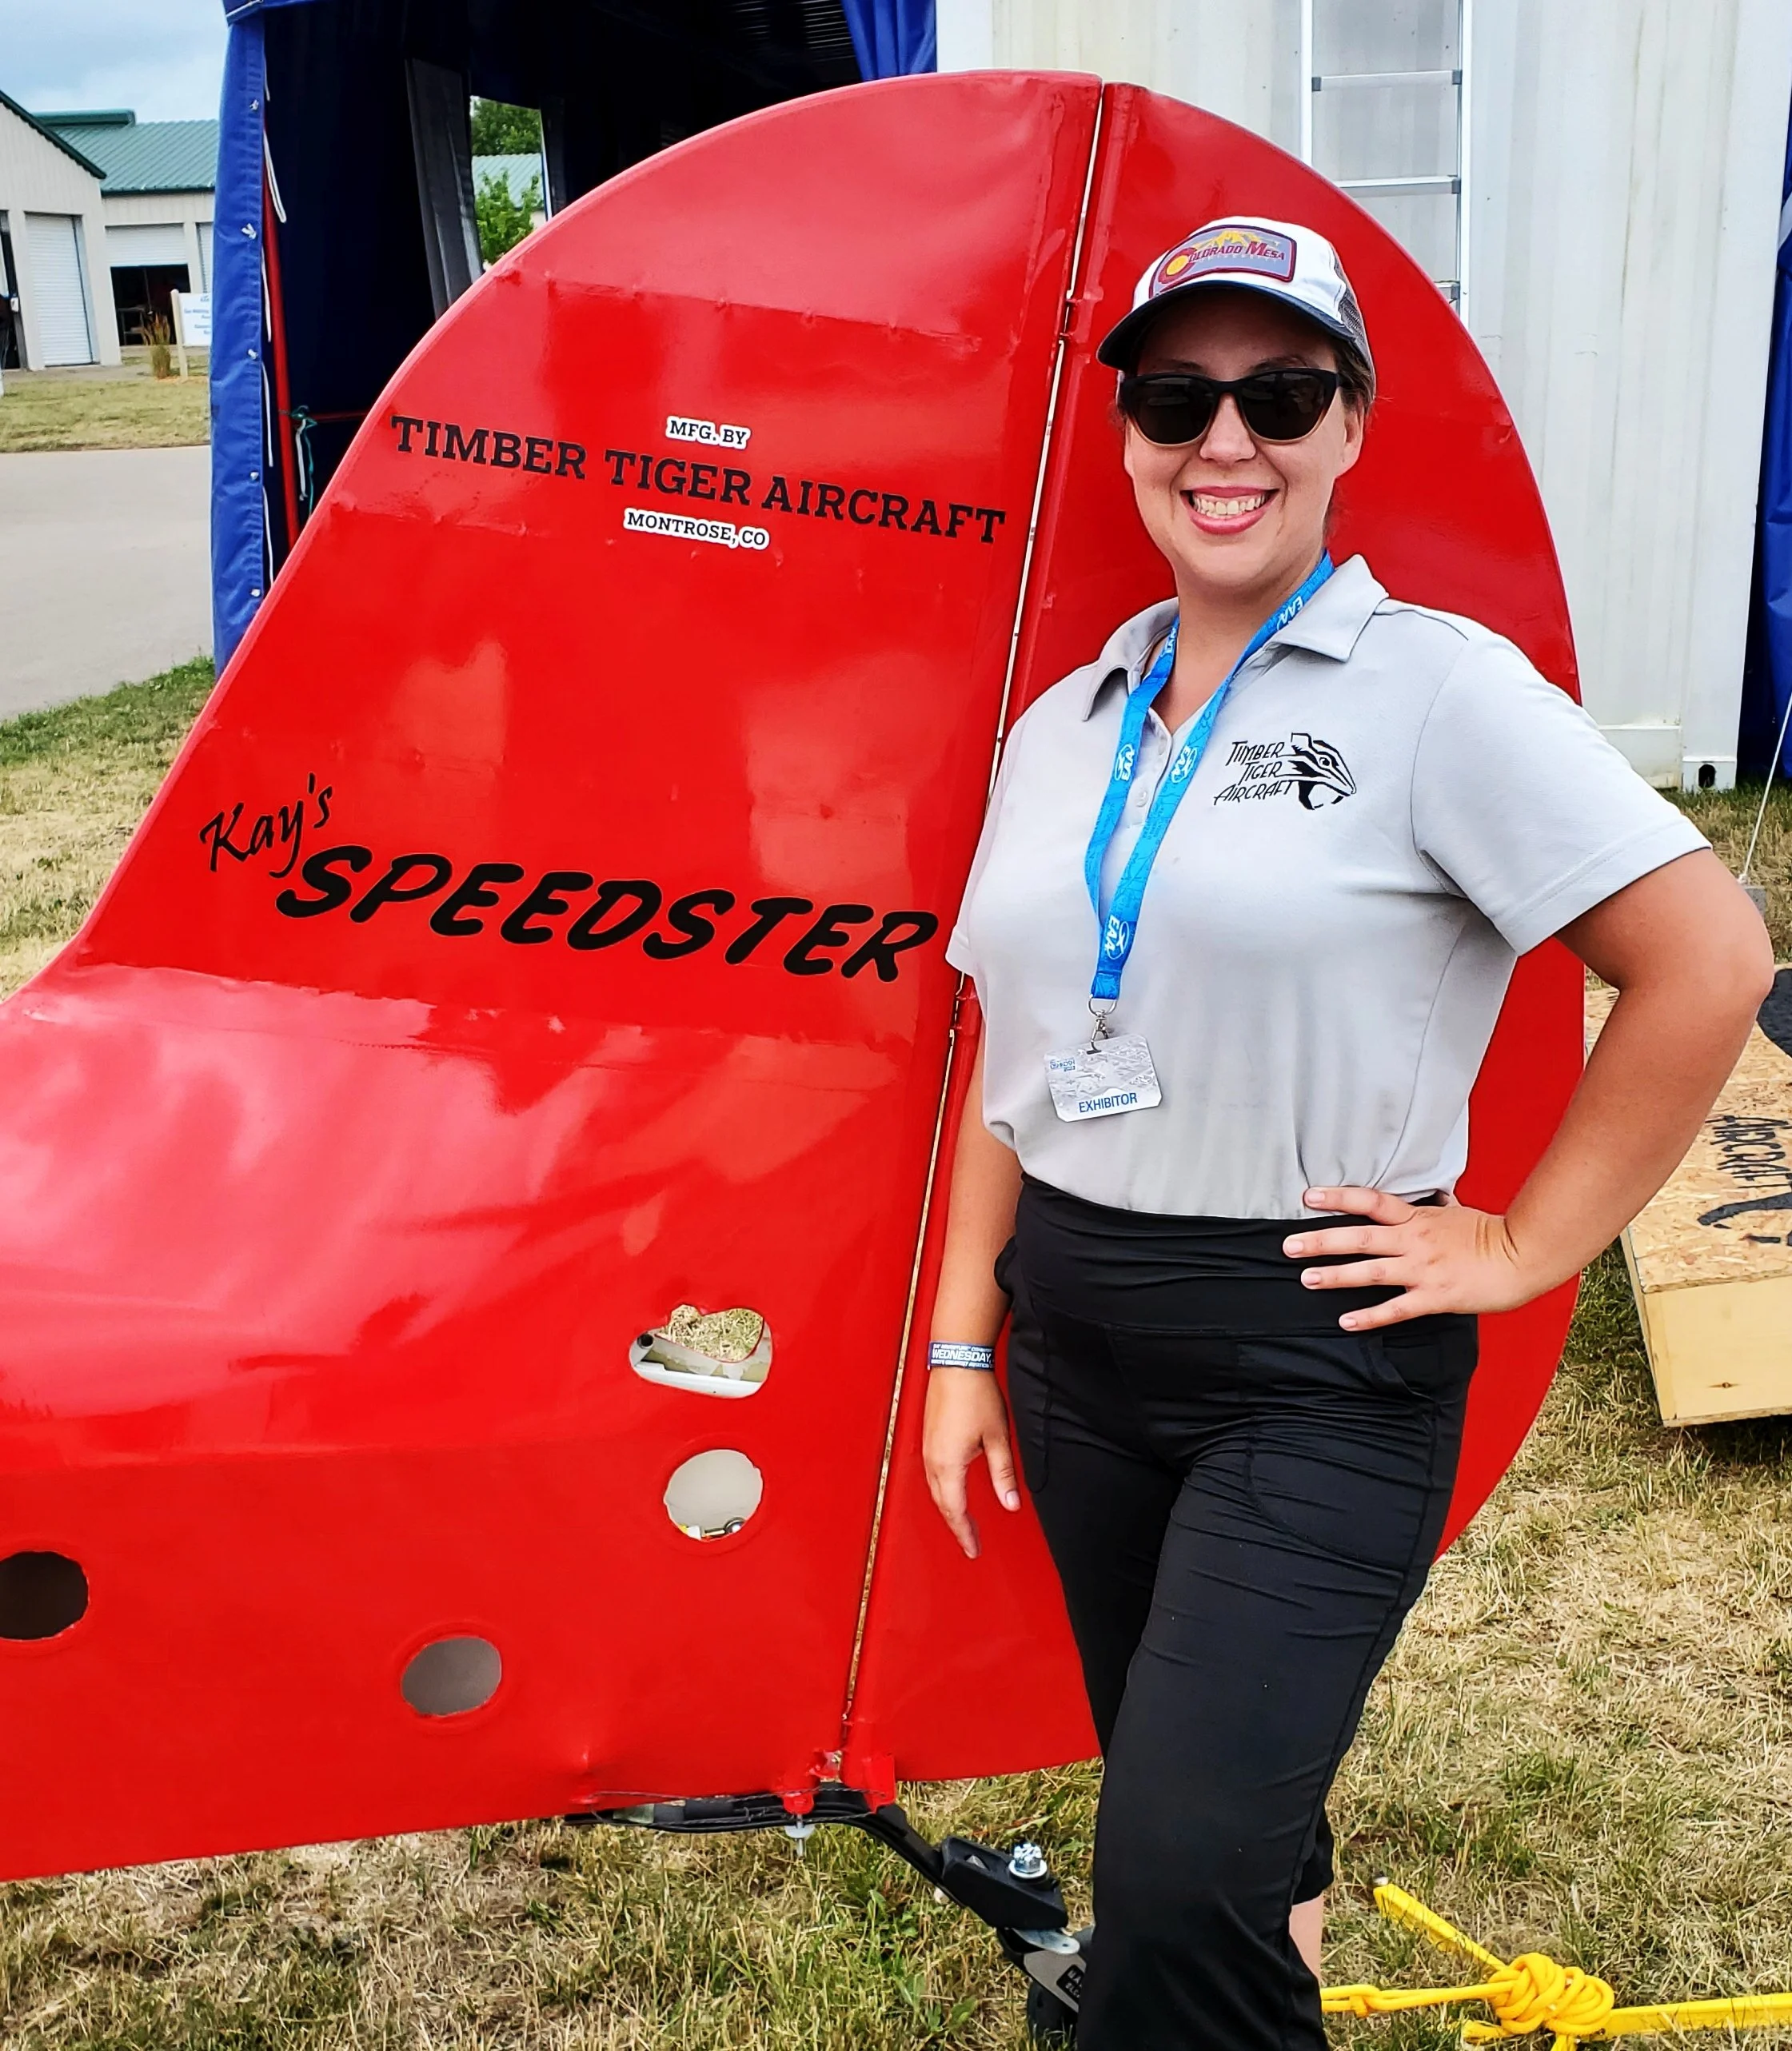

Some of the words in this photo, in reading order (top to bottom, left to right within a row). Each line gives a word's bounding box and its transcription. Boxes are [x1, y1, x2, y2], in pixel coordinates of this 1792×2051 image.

[1159, 245, 1242, 283] COLORADO
[1245, 241, 1285, 261] MESA
[669, 420, 716, 441] MFG.
[722, 429, 748, 445] BY
[391, 415, 586, 480] TIMBER
[605, 449, 751, 505] TIGER
[761, 476, 1006, 544] AIRCRAFT
[627, 512, 737, 545] MONTROSE,
[740, 528, 767, 547] CO
[1279, 596, 1303, 624] EAA
[1121, 750, 1135, 781] EAA
[1171, 745, 1191, 776] EAA
[1226, 740, 1285, 766] TIMBER
[1238, 761, 1283, 785] TIGER
[1214, 780, 1296, 805] AIRCRAFT
[199, 772, 333, 879] Kay's
[276, 844, 939, 982] SPEEDSTER
[1104, 915, 1120, 952] EAA
[1079, 1092, 1138, 1113] EXHIBITOR
[932, 1348, 992, 1363] WEDNESDAY
